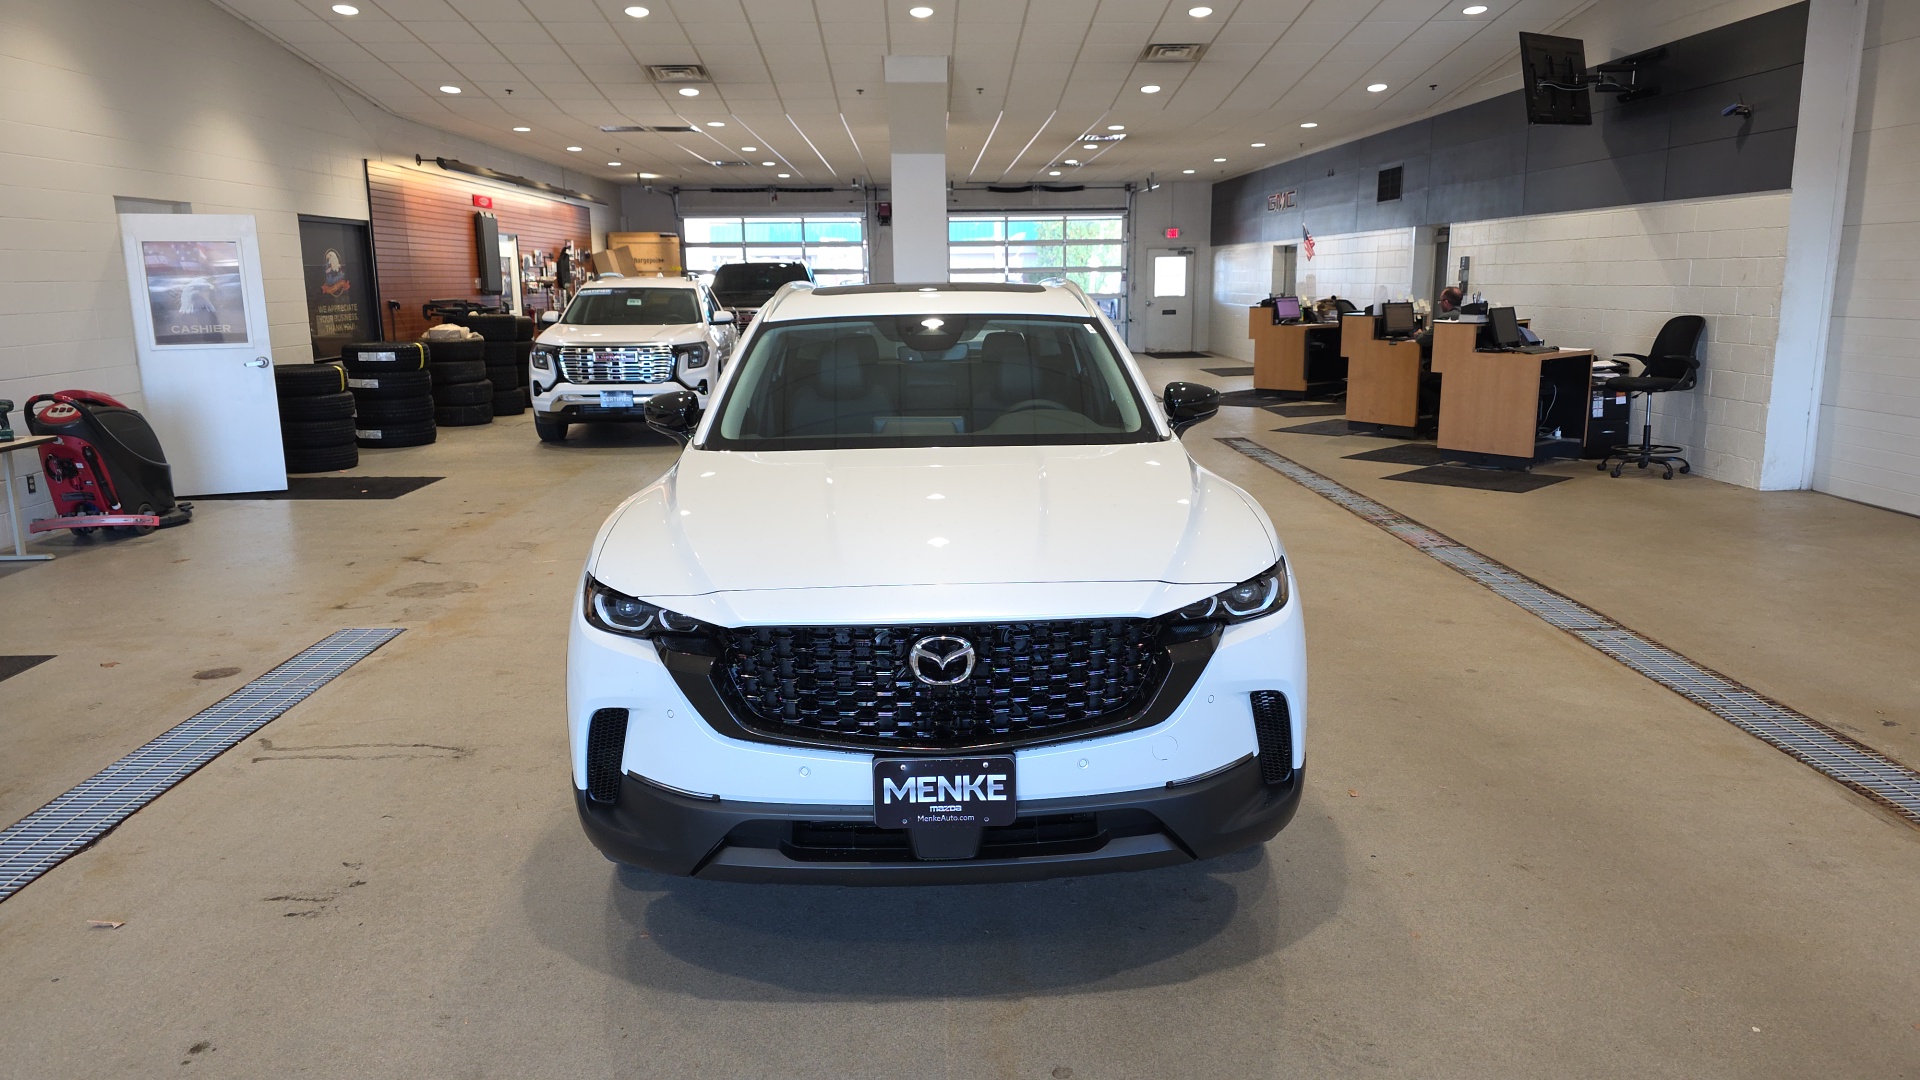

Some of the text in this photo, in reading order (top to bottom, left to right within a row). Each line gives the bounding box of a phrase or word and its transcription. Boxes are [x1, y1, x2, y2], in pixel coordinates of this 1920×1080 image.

[1267, 189, 1298, 211] GMC
[318, 303, 357, 313] WE APPRECIATE
[320, 315, 334, 323] YOUR
[171, 324, 231, 334] CASHIER
[325, 323, 343, 332] THANK
[883, 774, 1007, 804] MENKE
[917, 814, 975, 822] MenkeAuto.com
